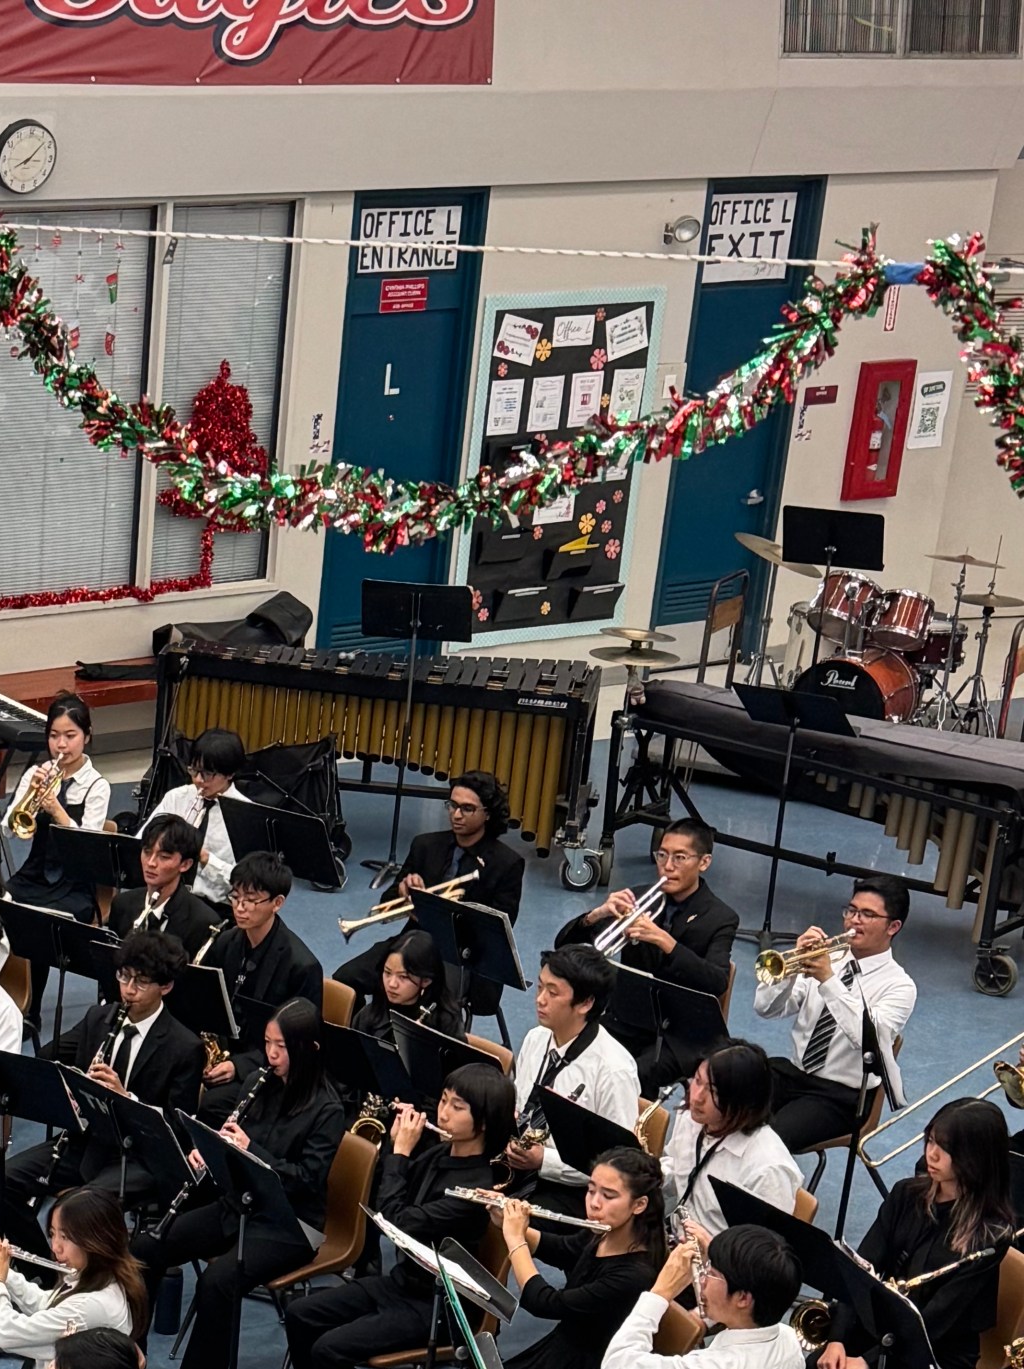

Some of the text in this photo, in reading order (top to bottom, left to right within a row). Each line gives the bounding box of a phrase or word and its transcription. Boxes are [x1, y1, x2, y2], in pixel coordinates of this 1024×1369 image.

[363, 209, 457, 239] OFFICE L
[710, 198, 792, 225] OFFICE L
[360, 240, 456, 270] ENTRANCE
[706, 230, 785, 265] EXIT
[556, 320, 582, 340] Office
[384, 363, 400, 396] L
